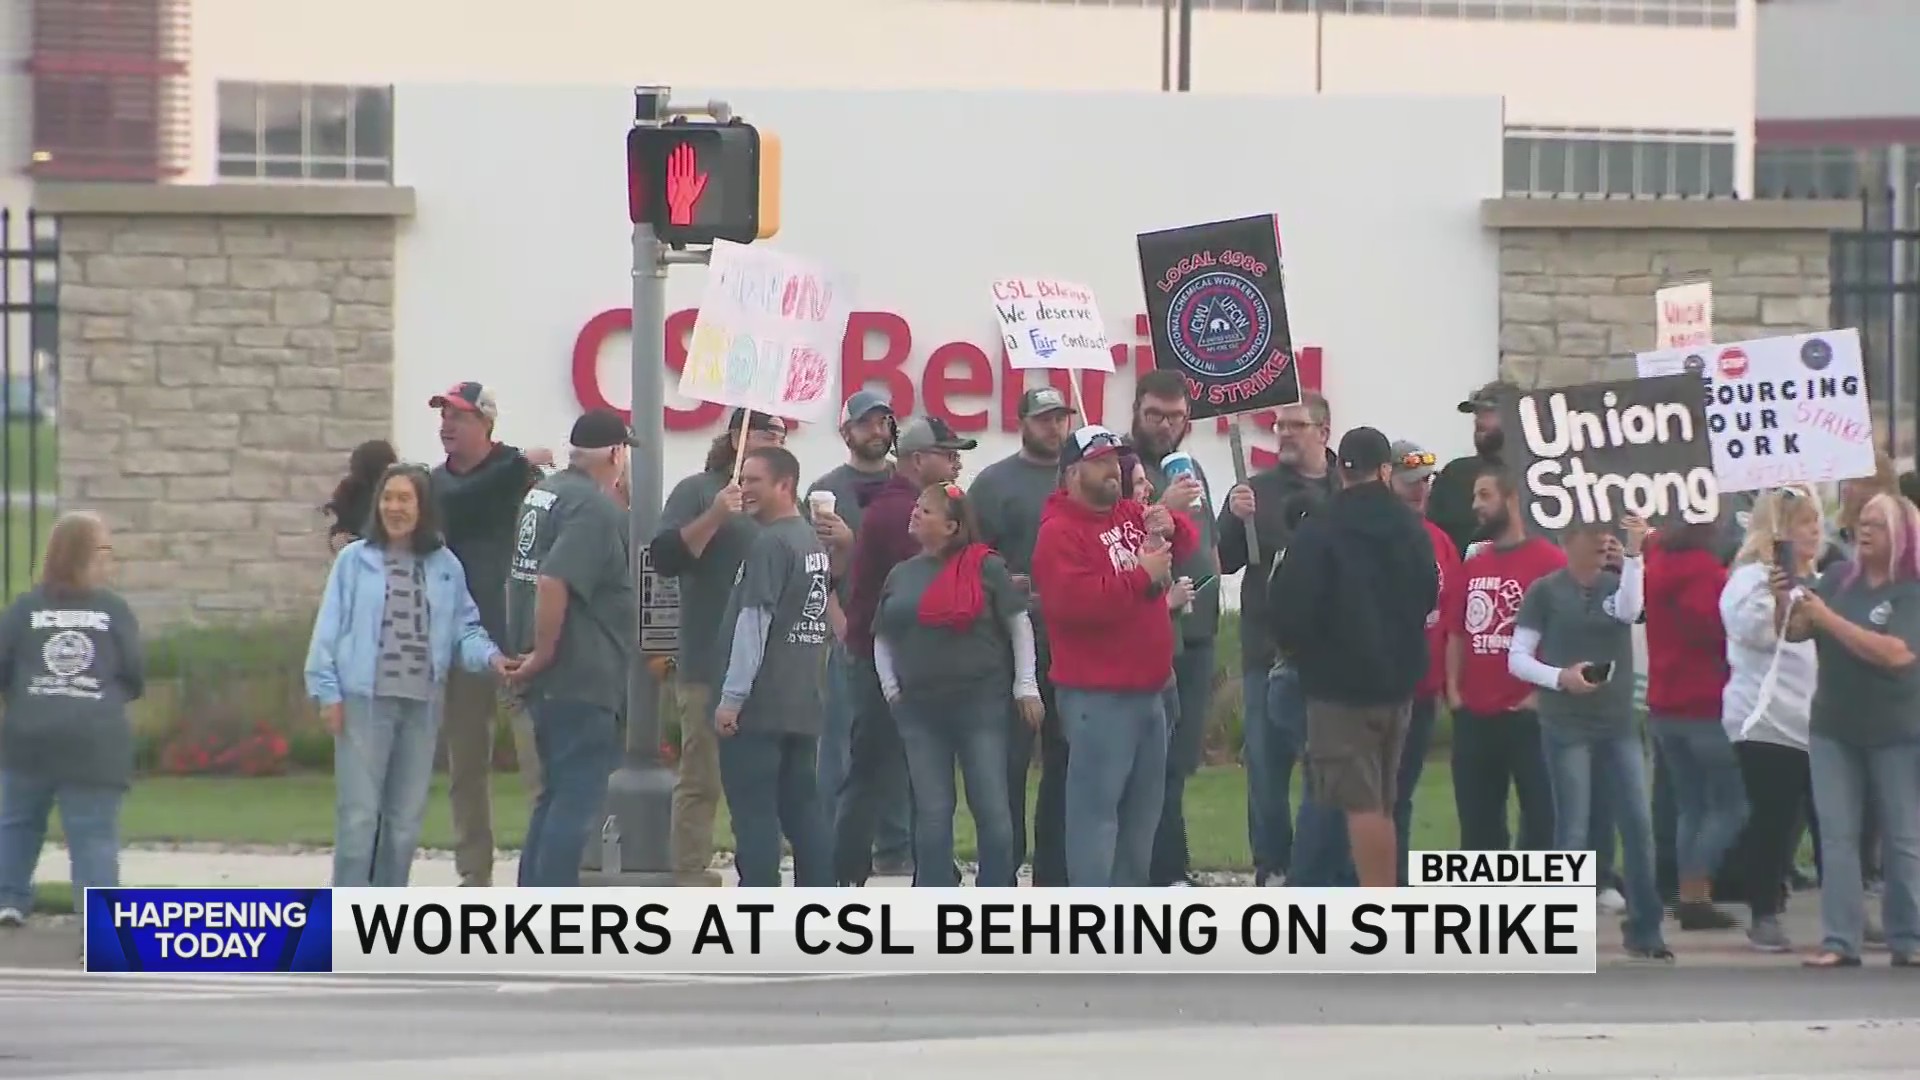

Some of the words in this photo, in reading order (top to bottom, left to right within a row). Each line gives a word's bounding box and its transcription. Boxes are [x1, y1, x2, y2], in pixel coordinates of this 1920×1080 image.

[1157, 251, 1217, 292] LOCAL
[1219, 250, 1267, 278] 498C
[992, 280, 1033, 301] CSL
[1176, 278, 1213, 313] CHEMICAL
[1214, 277, 1257, 300] WORKERS
[996, 303, 1027, 325] We
[1036, 300, 1092, 321] deserve
[1189, 304, 1209, 334] ICWU
[1221, 296, 1250, 328] UFCW
[1252, 298, 1267, 332] UNION
[1005, 334, 1018, 349] a
[1028, 328, 1057, 351] Fair
[1170, 313, 1216, 371] INTERNATIONAL
[1236, 332, 1265, 366] COUNCIL
[1207, 349, 1290, 404] STRIKE
[1519, 393, 1693, 458] Union
[1709, 409, 1778, 434] OUR
[1727, 433, 1800, 459] ORK
[1526, 457, 1720, 529] Strong
